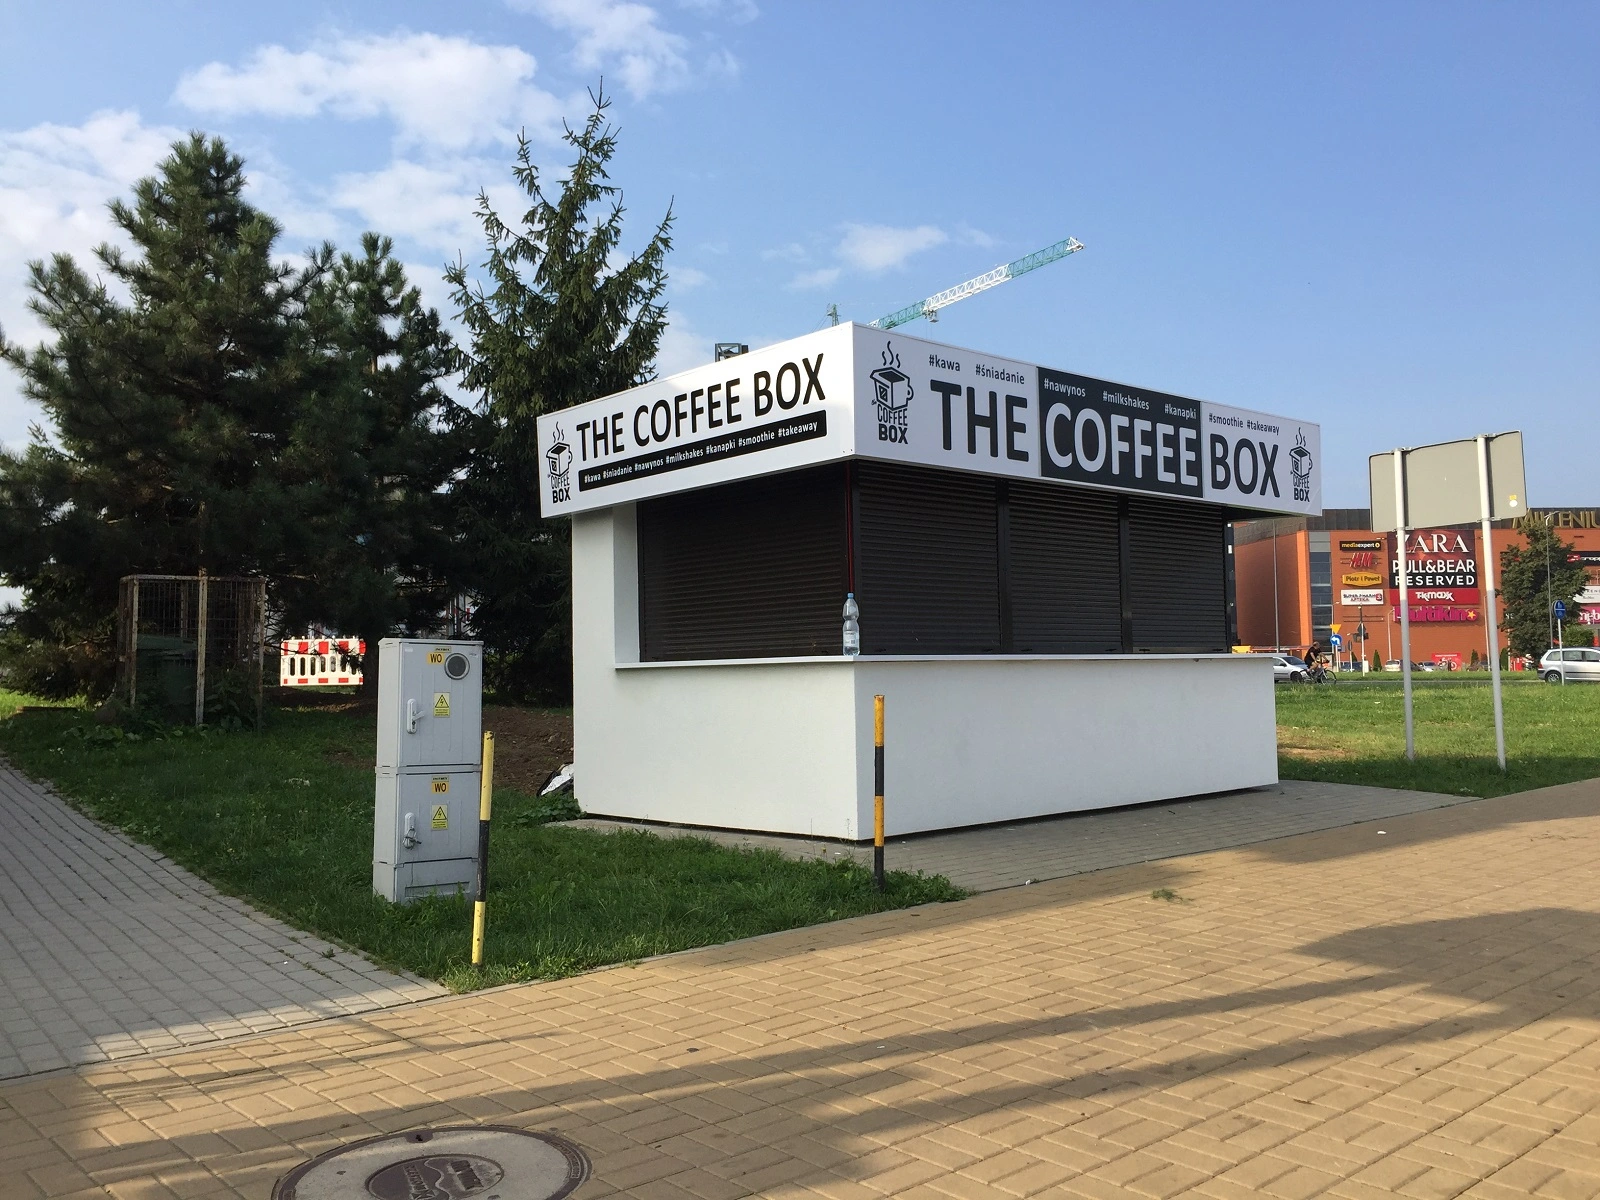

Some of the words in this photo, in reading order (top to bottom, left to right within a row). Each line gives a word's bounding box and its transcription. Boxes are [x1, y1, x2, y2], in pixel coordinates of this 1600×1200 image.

[928, 354, 961, 372] #kawa
[975, 363, 1025, 385] #śniadanie
[576, 412, 624, 461] THE
[633, 378, 742, 447] COFFEE
[754, 353, 826, 417] BOX
[1043, 378, 1086, 397] #nawynos
[1102, 390, 1150, 411] #milkshakes
[1164, 403, 1197, 420] #kanapki
[877, 404, 908, 426] COFFEE
[1208, 412, 1244, 429] #smoothie
[1246, 420, 1280, 436] #takeaway
[878, 423, 908, 444] BOX
[930, 379, 1029, 462] THE
[1045, 402, 1198, 487] COFFEE
[1210, 433, 1281, 498] BOX
[584, 473, 601, 484] #kawa
[602, 465, 633, 480] #śniadanie
[634, 458, 664, 472] #nawynos
[665, 448, 704, 464] #milkshakes
[705, 439, 736, 455] #kanapki
[738, 431, 775, 447] #smoothie
[777, 421, 818, 438] #takeaway
[551, 470, 570, 489] COFFEE
[552, 487, 571, 504] BOX
[1293, 488, 1310, 502] BOX
[430, 653, 442, 663] WO
[434, 782, 446, 792] WO
